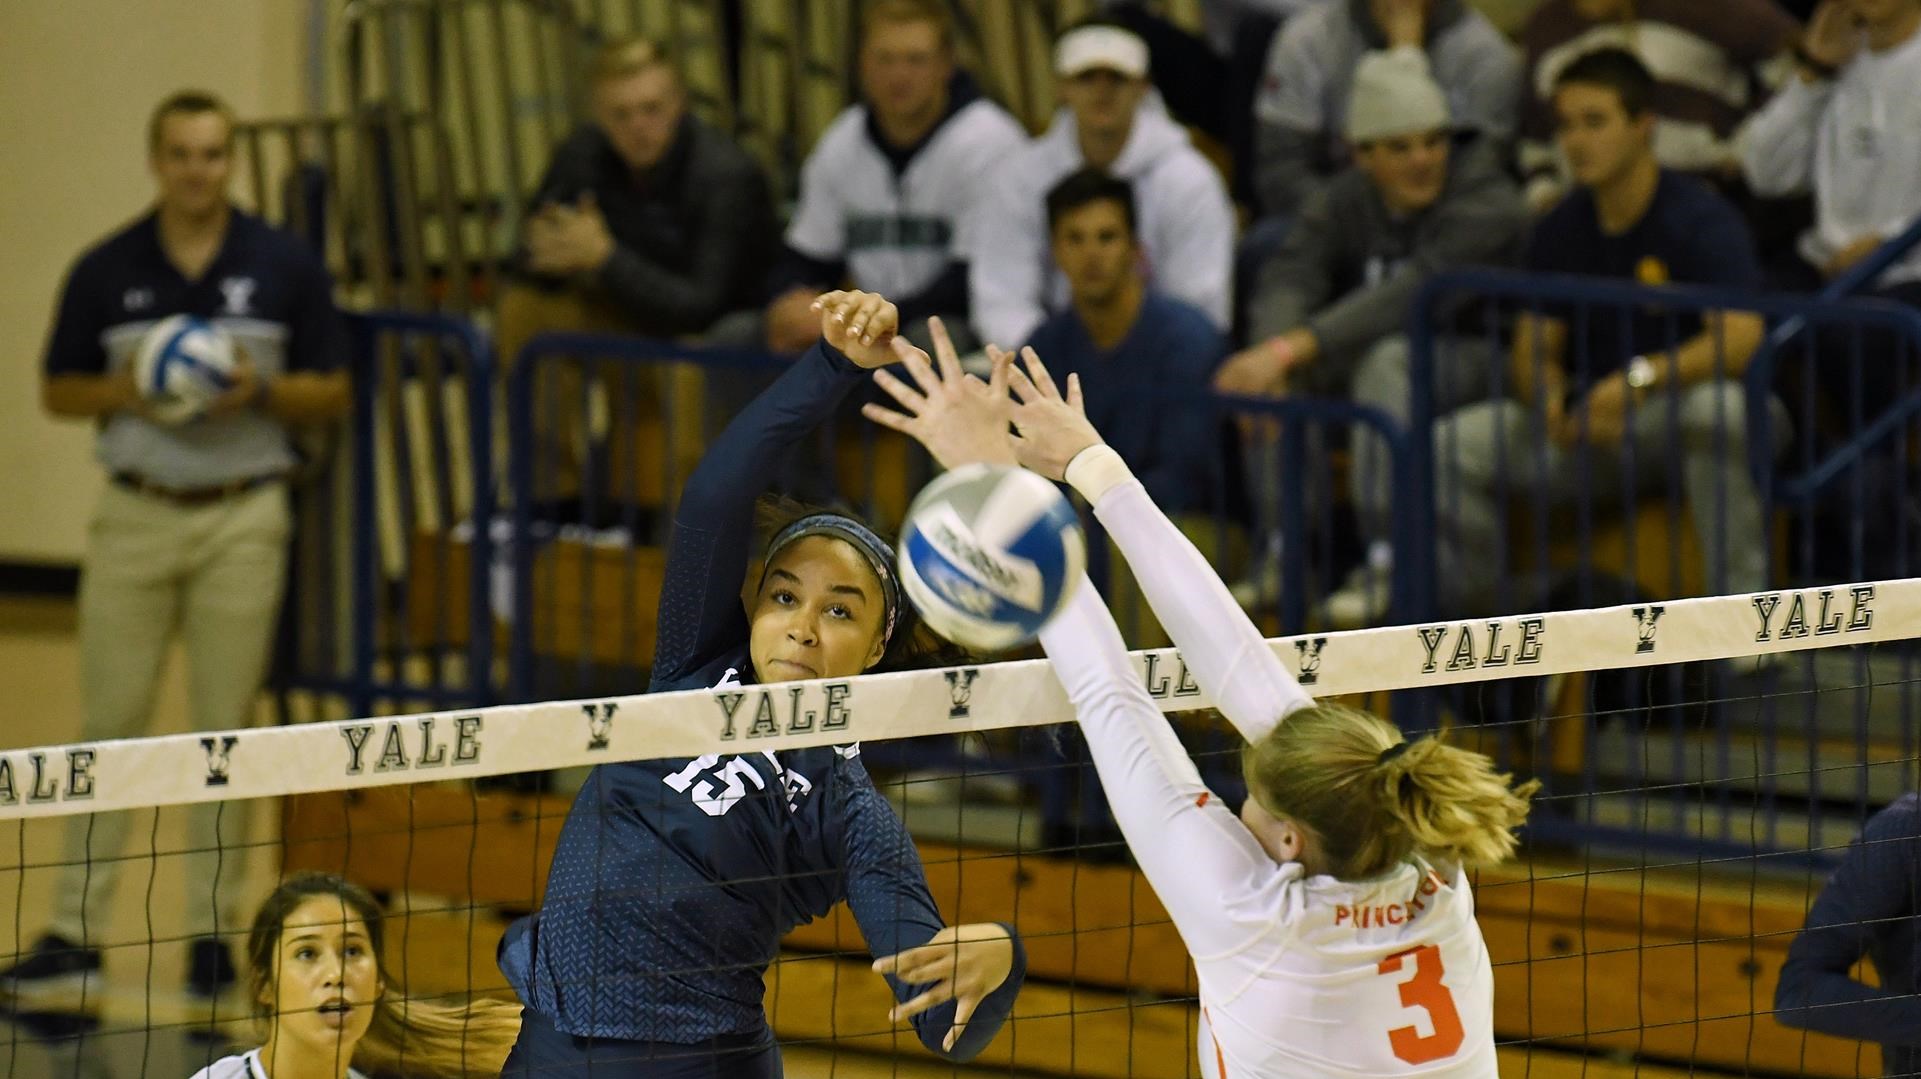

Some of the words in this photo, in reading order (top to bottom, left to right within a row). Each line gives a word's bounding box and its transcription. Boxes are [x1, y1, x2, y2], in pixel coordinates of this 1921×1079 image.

[0, 747, 96, 804] ALE
[339, 713, 482, 775] YALE
[713, 680, 852, 742] YALE
[1144, 650, 1201, 699] LE
[1417, 616, 1545, 674] YALE
[1752, 585, 1876, 643] YALE
[662, 751, 765, 817] 15
[1377, 944, 1466, 1066] 3
